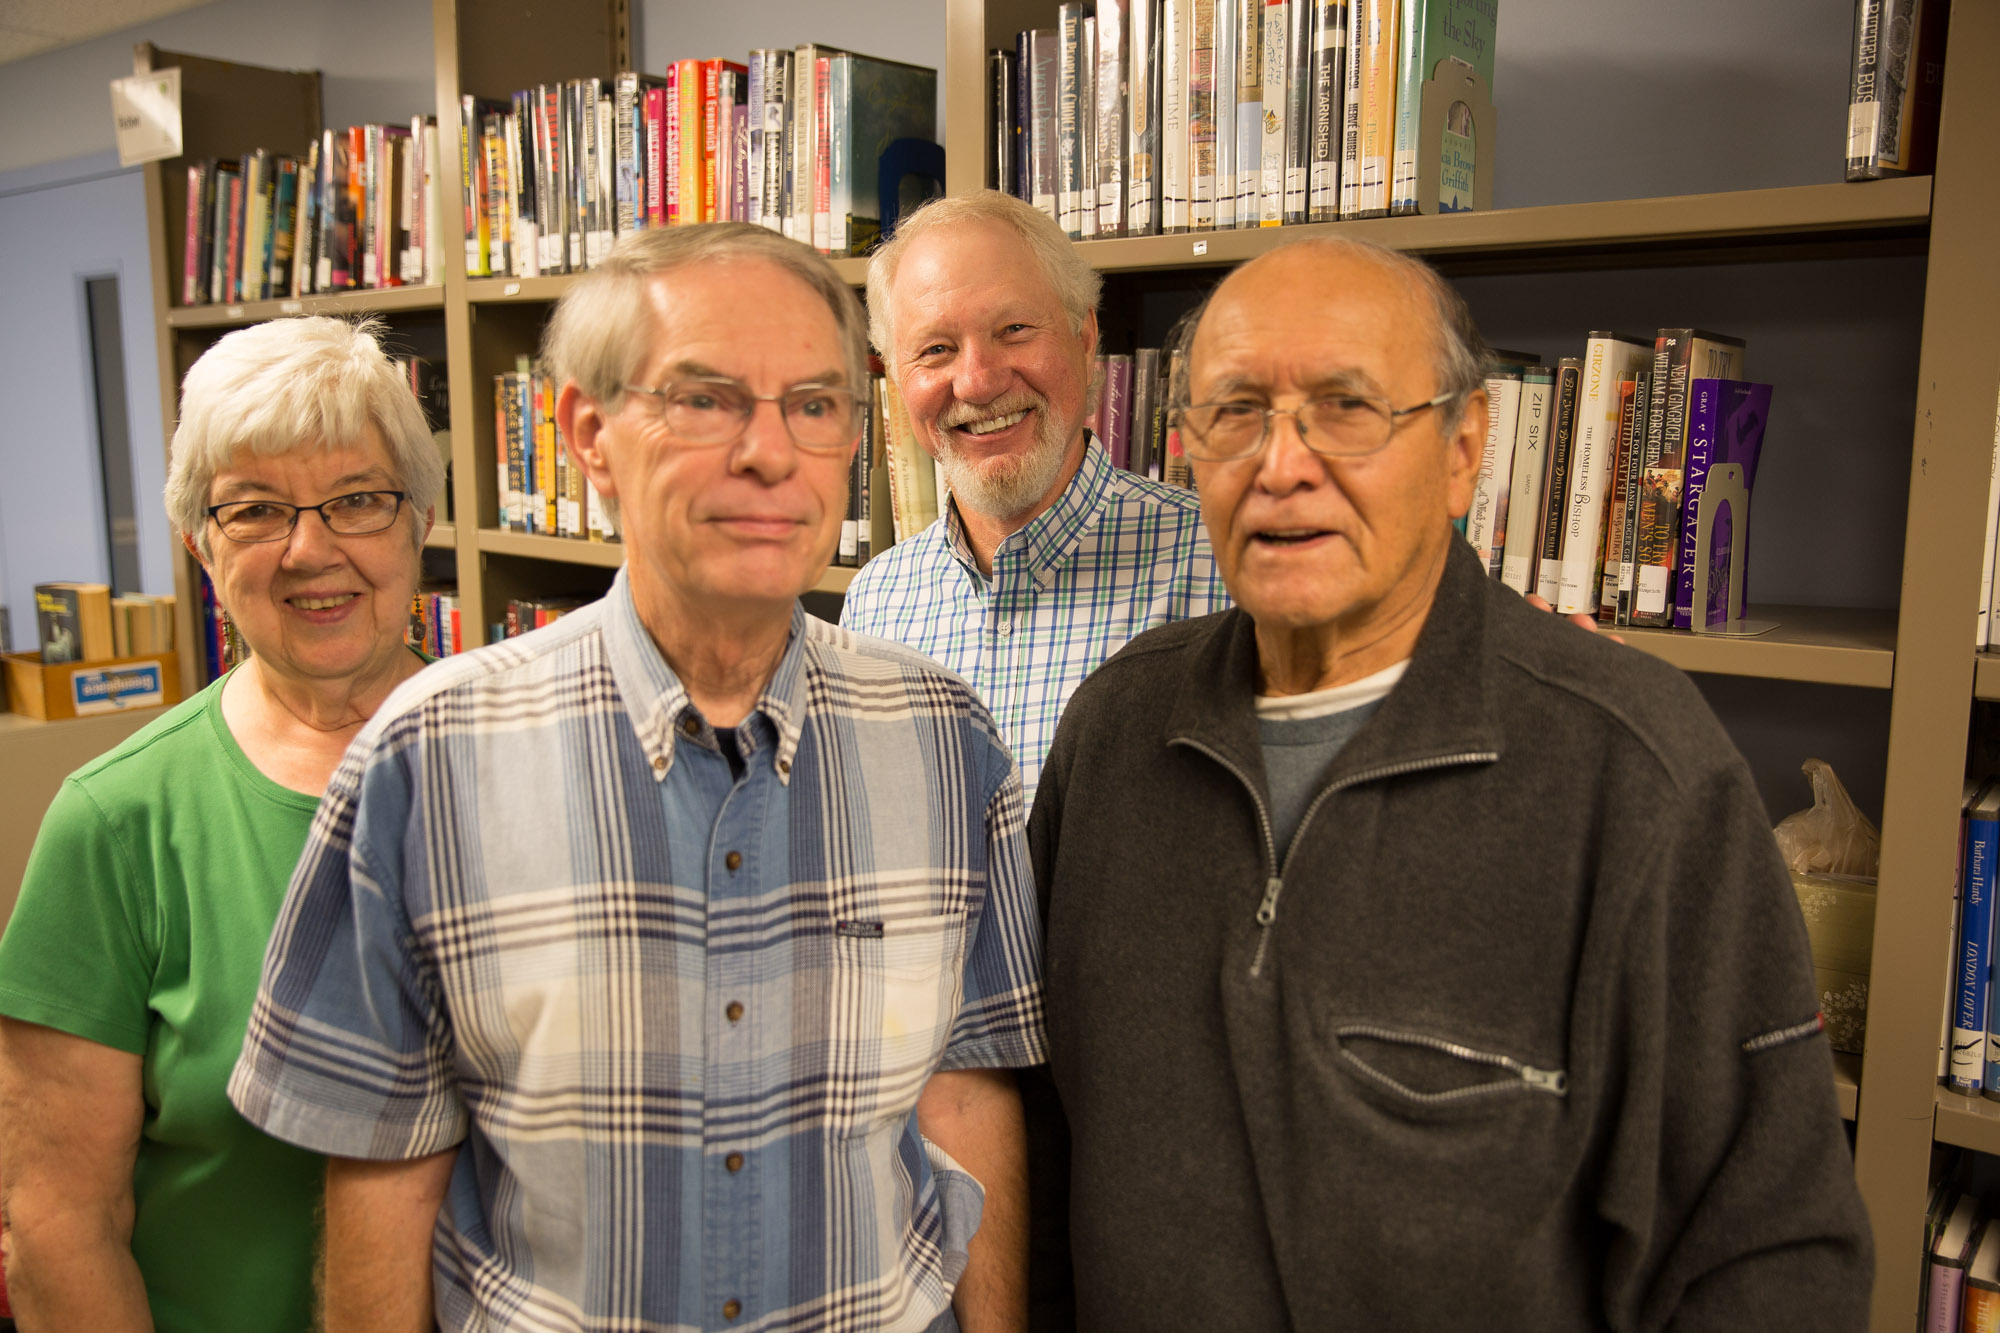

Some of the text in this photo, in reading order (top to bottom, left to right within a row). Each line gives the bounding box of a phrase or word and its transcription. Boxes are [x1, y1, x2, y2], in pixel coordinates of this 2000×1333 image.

[1443, 8, 1462, 42] the
[1464, 19, 1485, 59] Sky
[705, 67, 717, 97] Janet
[1061, 17, 1078, 134] THE PEOPLE'S CHOICE
[1200, 51, 1210, 87] TERRAIN
[1167, 91, 1179, 131] TIME
[1316, 63, 1331, 158] THE TARNISHED
[1367, 68, 1380, 118] Parrot's
[705, 99, 717, 152] Evanovich
[1348, 103, 1360, 129] HERVÉ
[1401, 111, 1410, 150] Brownin
[737, 169, 745, 202] GLASS
[1441, 168, 1469, 192] Griffith
[1564, 377, 1575, 397] BET
[1588, 343, 1604, 400] GIRZONE
[1652, 351, 1669, 394] WILLIAM
[508, 386, 517, 428] PLACE
[1532, 392, 1543, 418] ZIP
[1560, 399, 1573, 426] YOUR
[1636, 381, 1645, 407] PIANO
[1663, 364, 1687, 454] NEWT GINGRICH and
[1479, 382, 1503, 480] DOROTHY GARLOCK
[1527, 424, 1539, 450] SIX
[1634, 410, 1643, 436] MUSIC
[1646, 409, 1664, 468] FORSTCHEN
[510, 434, 520, 466] LAST
[1557, 429, 1569, 463] BOTTOM
[1616, 402, 1634, 495] BLIND FAITH
[1632, 439, 1640, 455] FOR
[1553, 465, 1565, 500] DOLLAR
[1580, 441, 1592, 491] HOMELESS
[1630, 457, 1639, 480] FOUR
[1683, 391, 1708, 575] GRAY STARGAZER
[1474, 498, 1490, 522] Week
[1571, 492, 1591, 537] BISHOP
[1627, 482, 1637, 511] HANDS
[1549, 511, 1558, 534] KARIN
[1611, 507, 1623, 554] SAGARIKA
[1625, 519, 1633, 545] ROGER
[1640, 502, 1657, 541] MEN'S
[1653, 523, 1671, 567] TO TRY
[1969, 839, 1986, 907] Barbara Hardy
[1962, 940, 1979, 1029] LONDON LOVER
